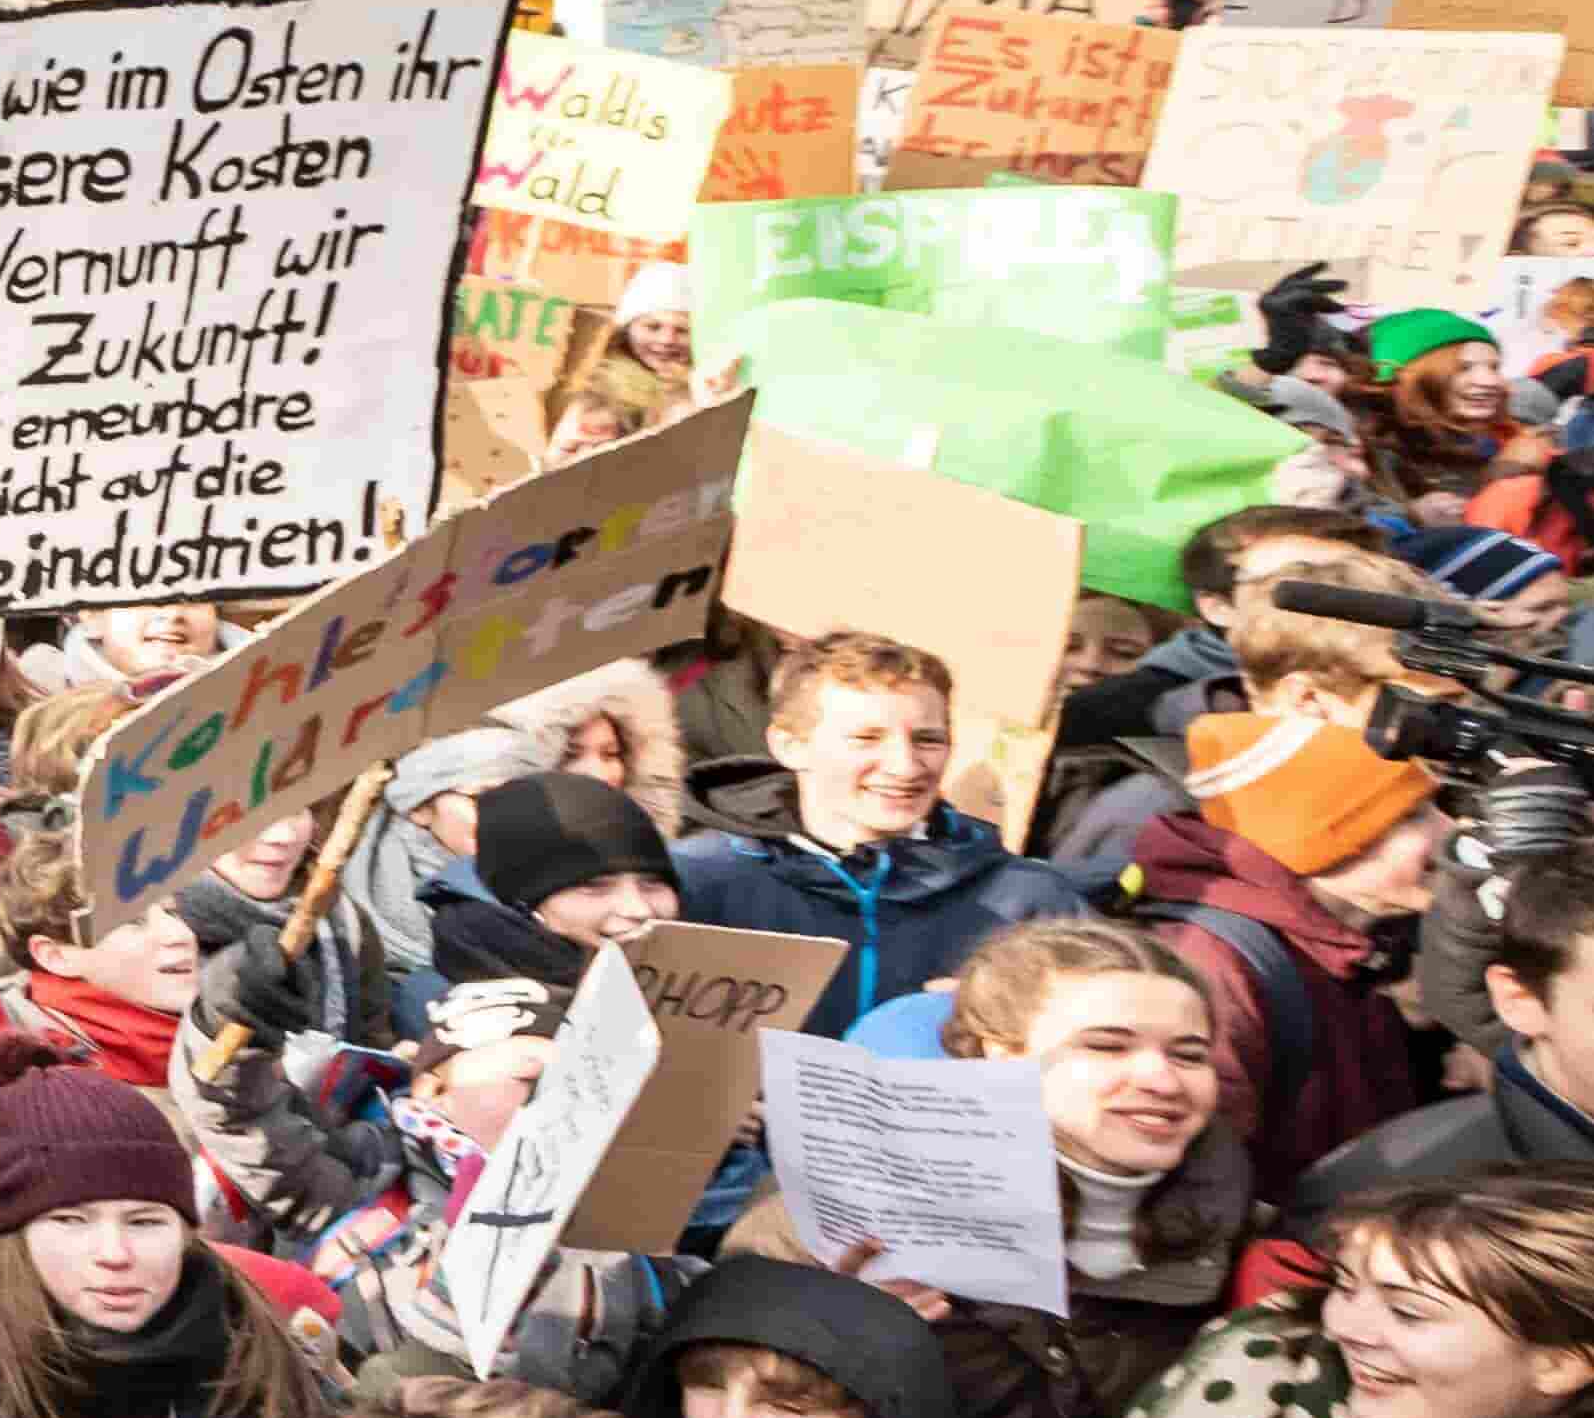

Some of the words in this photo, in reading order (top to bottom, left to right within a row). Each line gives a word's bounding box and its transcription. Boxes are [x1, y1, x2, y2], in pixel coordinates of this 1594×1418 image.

[2, 56, 86, 121] wie
[107, 51, 170, 114] im
[193, 20, 364, 114] Osten
[389, 7, 484, 107] ihr
[159, 118, 373, 205] Kosten
[477, 150, 623, 220] Wald
[274, 215, 388, 277] wir
[17, 283, 343, 395] Zukunft!
[456, 286, 578, 348] ATE
[101, 445, 183, 532] auf
[191, 441, 286, 502] die
[116, 718, 320, 905] Wald
